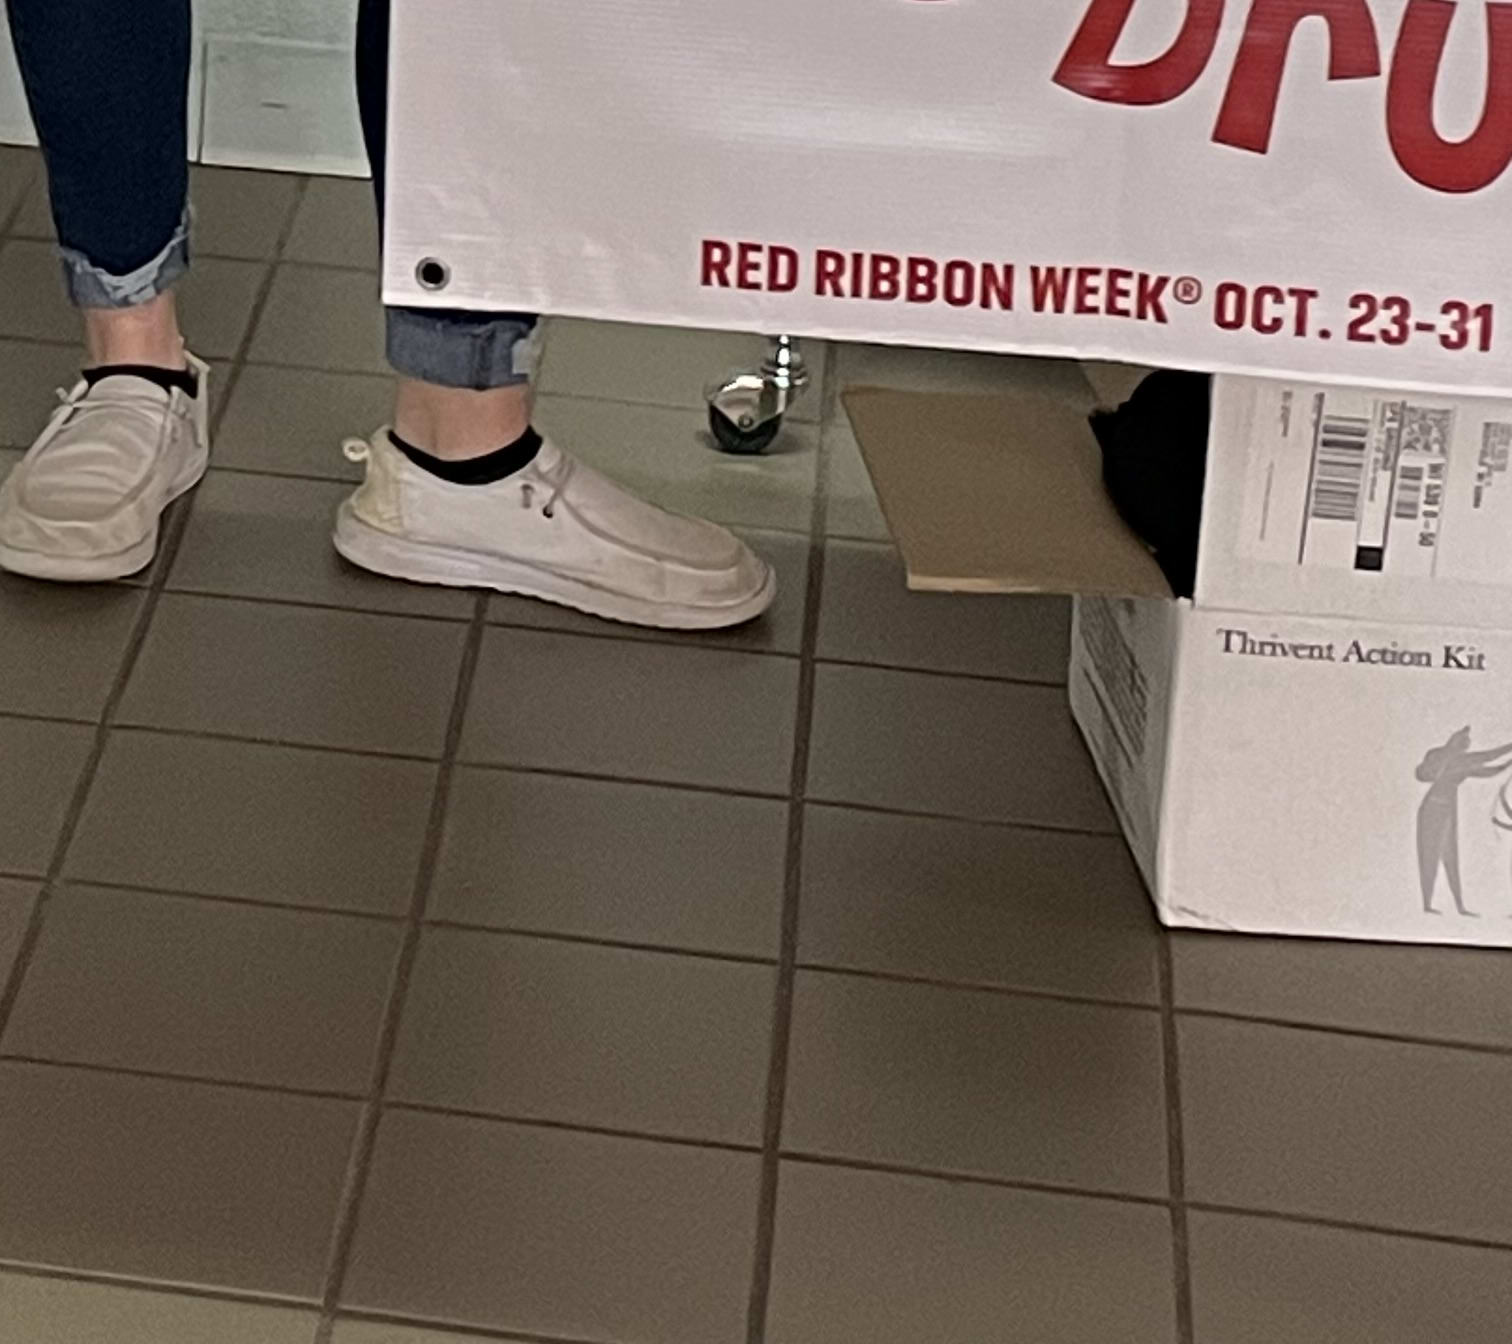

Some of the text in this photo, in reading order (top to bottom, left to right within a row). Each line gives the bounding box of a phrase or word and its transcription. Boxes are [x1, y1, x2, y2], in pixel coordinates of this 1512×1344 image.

[700, 238, 800, 294] RED
[813, 248, 1016, 312] RIBBON
[1213, 281, 1331, 340] OCT.
[1346, 292, 1495, 353] 23-31
[1216, 627, 1486, 672] Thrivent Action Kit
